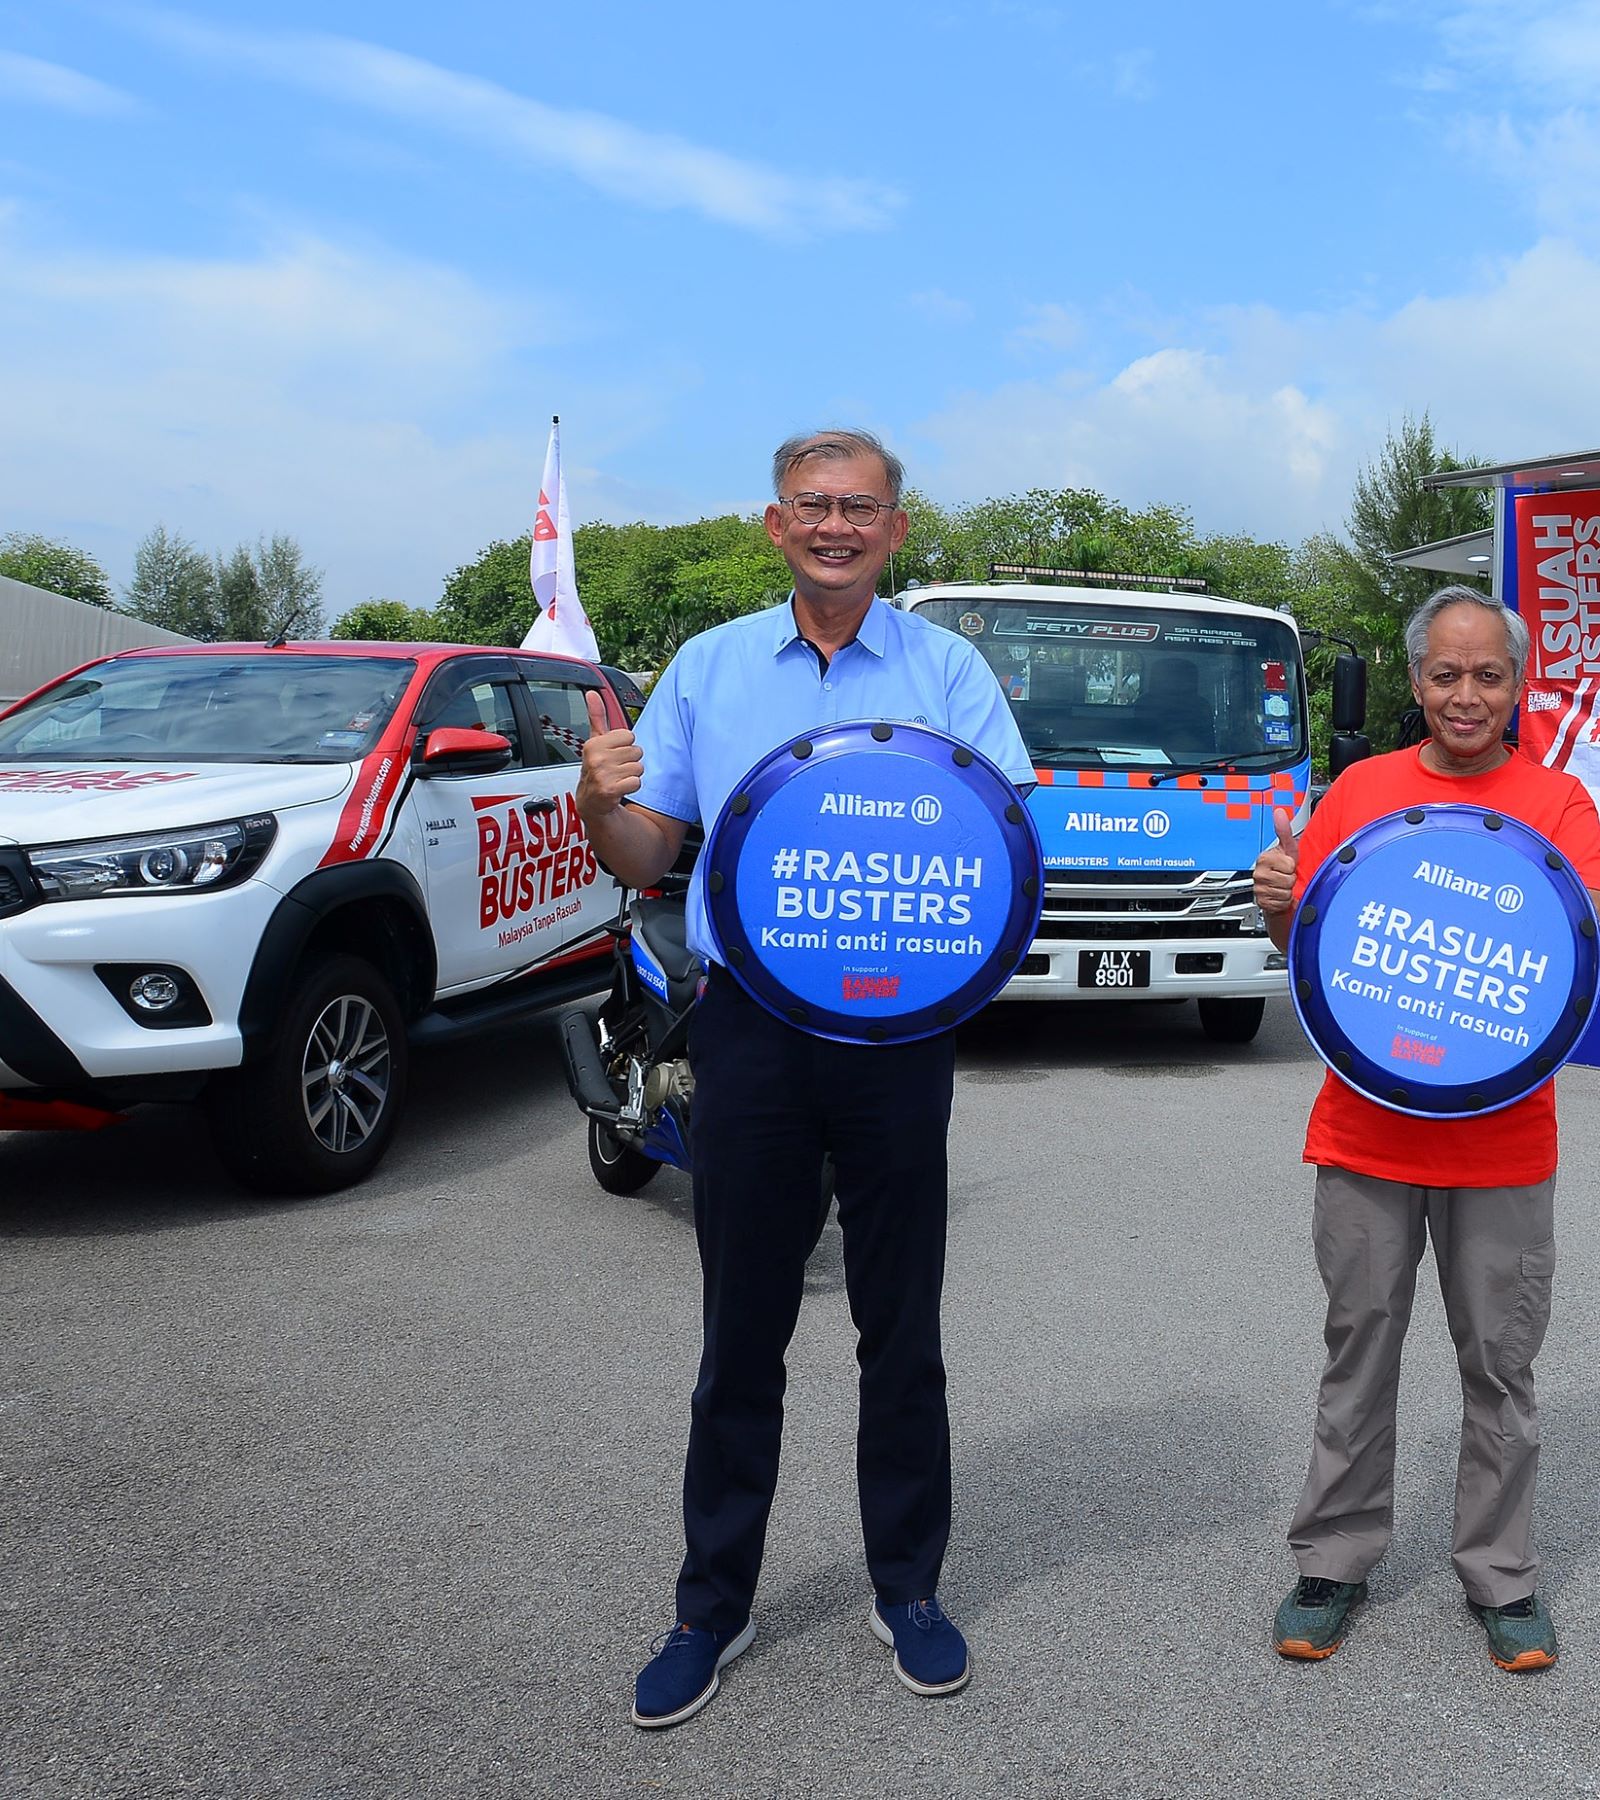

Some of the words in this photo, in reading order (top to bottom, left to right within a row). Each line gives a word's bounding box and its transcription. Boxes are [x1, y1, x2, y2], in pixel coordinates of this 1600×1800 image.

[1532, 514, 1583, 678] ASUAH
[1092, 625, 1150, 637] PLUS
[1528, 691, 1562, 704] RASUAH
[1528, 701, 1561, 713] BUSTERS
[349, 757, 393, 852] www.rasuahbusters.com
[819, 792, 906, 818] Allianz
[476, 791, 585, 877] RASUA
[1064, 812, 1139, 833] Allianz
[771, 848, 982, 888] #RASUAH
[1043, 856, 1109, 867] UAHBUSTERS
[1117, 856, 1142, 867] Kami
[1143, 857, 1162, 867] anti
[1163, 857, 1196, 867] rasuah
[480, 843, 597, 930] BUSTERS
[1413, 860, 1492, 901] Allianz
[776, 886, 972, 926] BUSTERS
[498, 920, 533, 949] Malaysia
[533, 911, 556, 933] Tanpa
[557, 898, 582, 922] Rasuah
[761, 927, 828, 949] Kami
[836, 931, 887, 951] anti
[895, 935, 982, 955] rasuah
[1356, 900, 1549, 984] #RASUAH
[852, 966, 878, 974] support
[1099, 951, 1131, 969] ALX
[843, 977, 900, 989] RASUAH
[1095, 968, 1133, 987] 8901
[1351, 935, 1530, 1016] BUSTERS
[843, 987, 897, 1001] BUSTERS
[1330, 969, 1393, 1004] Kami
[1397, 994, 1445, 1020] anti
[1449, 1009, 1530, 1048] rasuah
[1392, 1034, 1447, 1056] RASUAH
[1404, 1027, 1429, 1039] support
